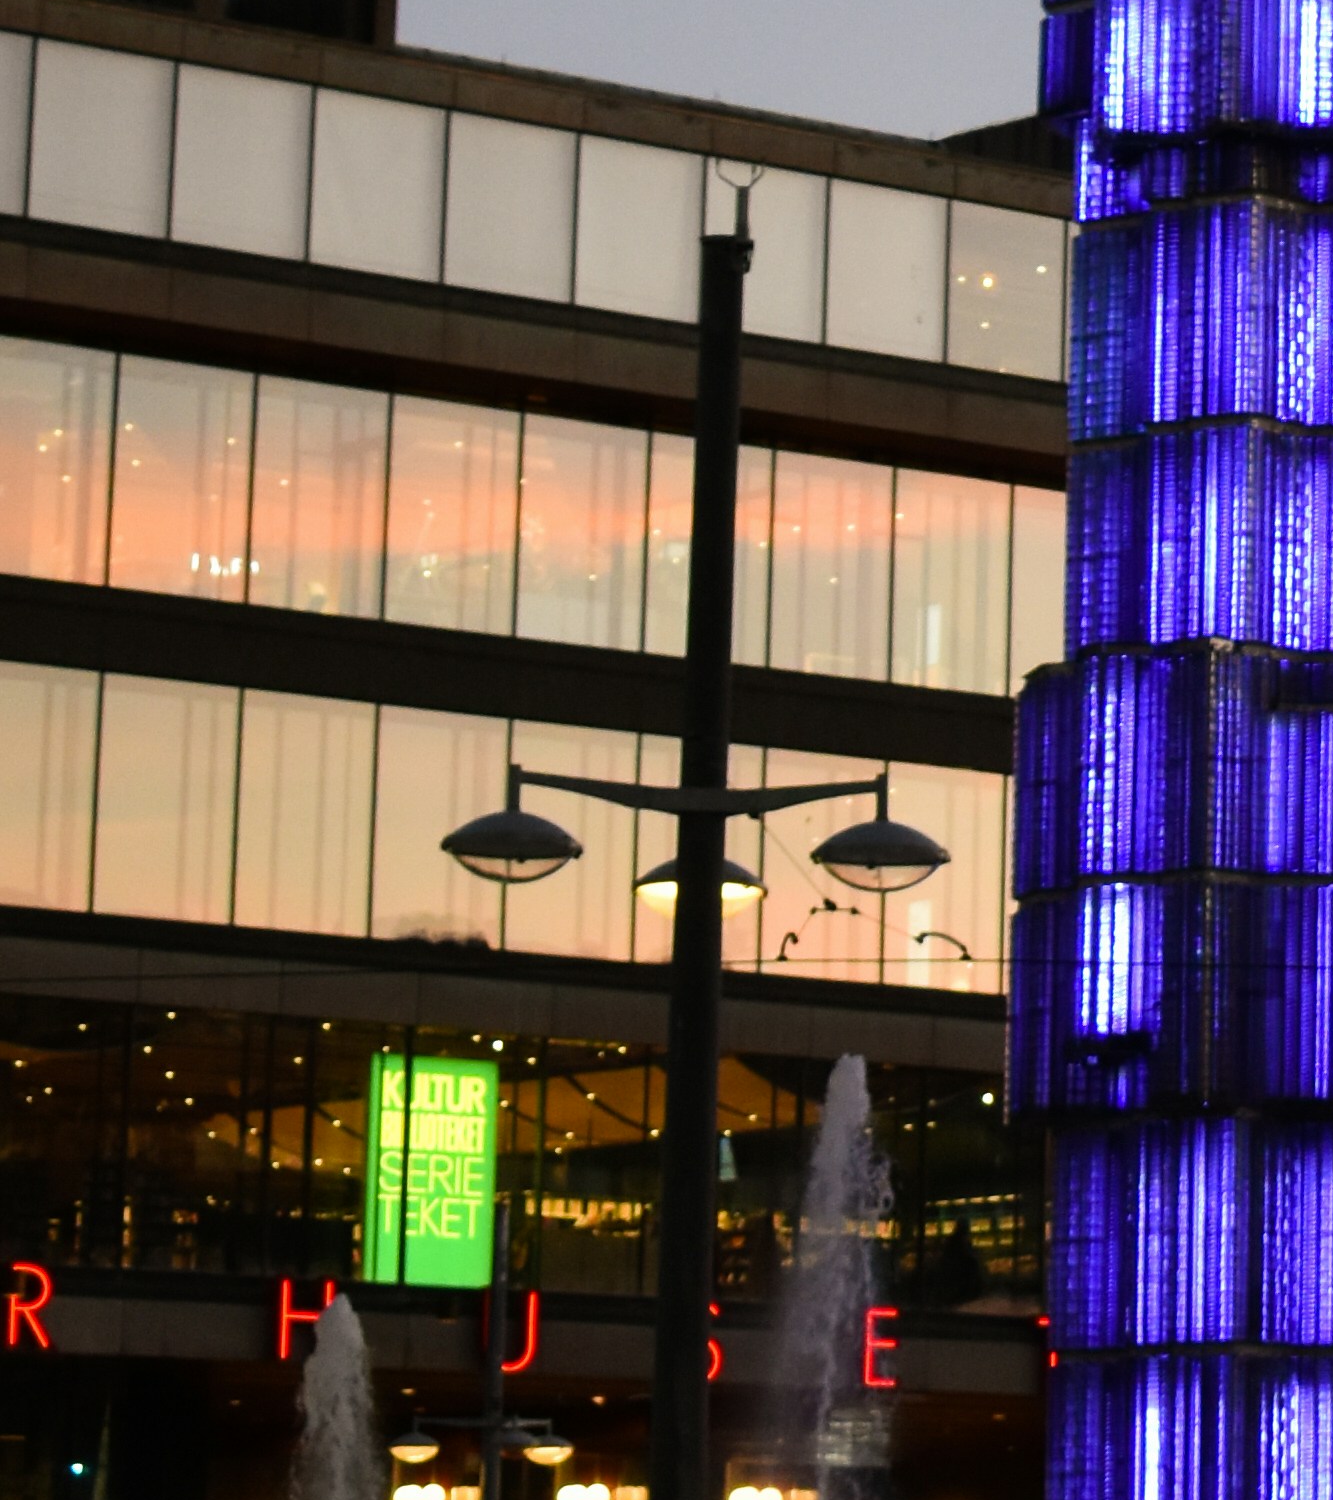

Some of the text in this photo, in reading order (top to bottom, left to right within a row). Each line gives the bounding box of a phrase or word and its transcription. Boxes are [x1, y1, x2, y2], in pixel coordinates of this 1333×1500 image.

[380, 1109, 486, 1153] BILIOTEKET
[378, 1150, 486, 1198] SERIE
[377, 1193, 484, 1240] TEKET
